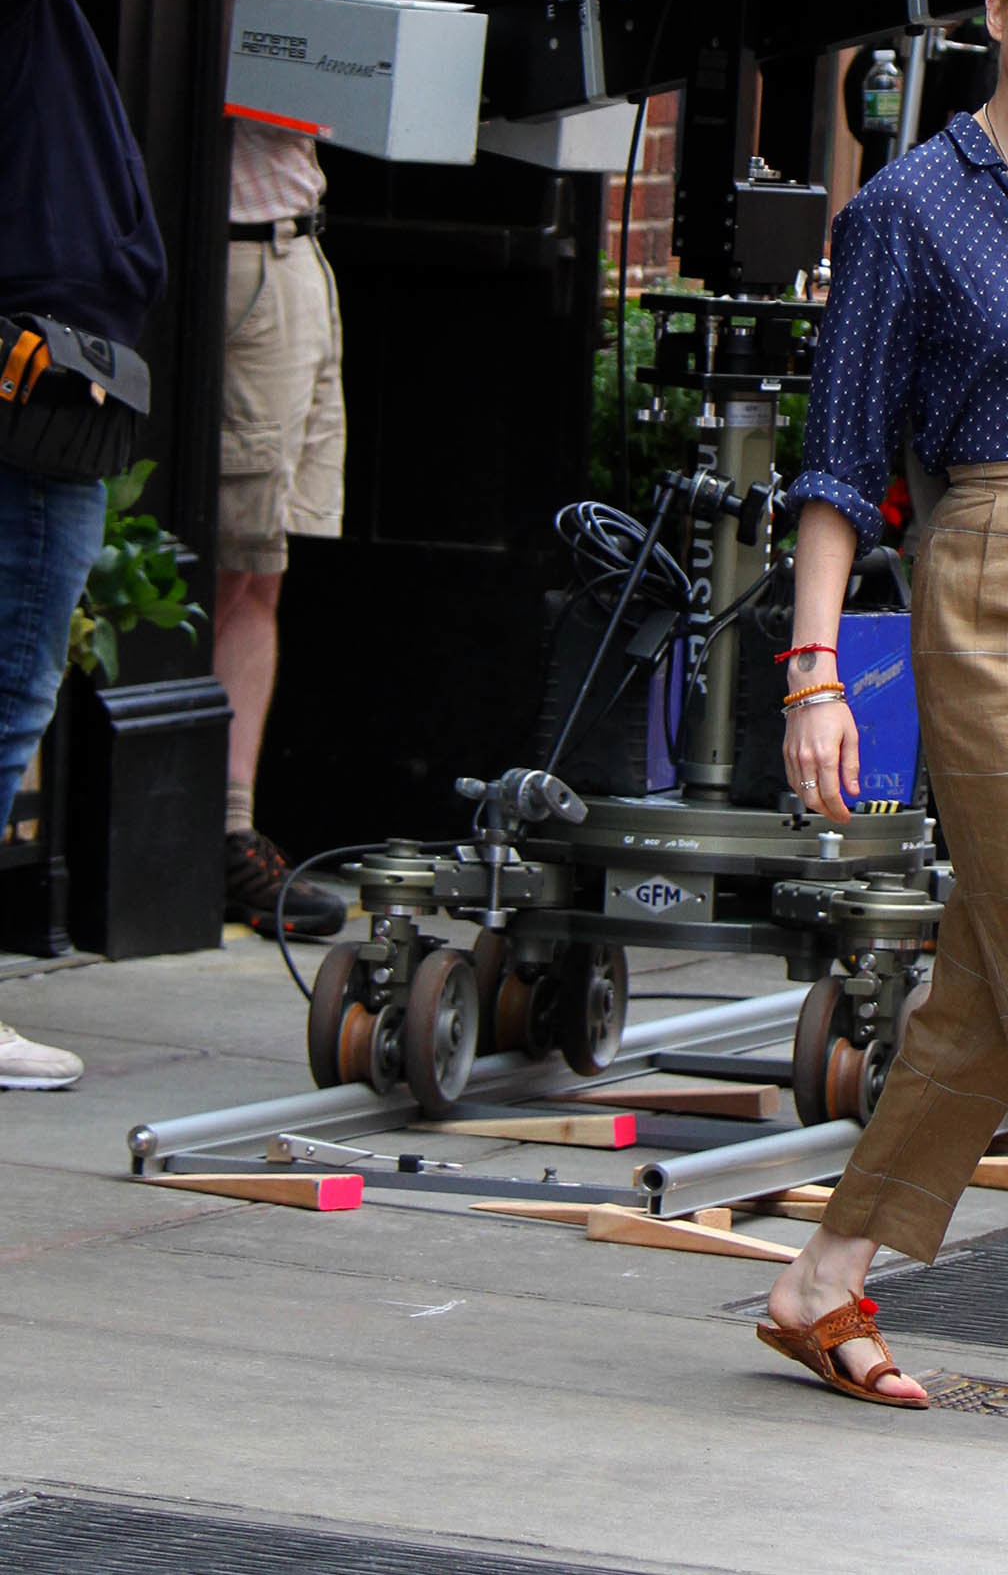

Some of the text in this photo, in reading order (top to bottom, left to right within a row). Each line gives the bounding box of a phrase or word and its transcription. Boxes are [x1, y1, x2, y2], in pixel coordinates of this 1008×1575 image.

[243, 29, 308, 47] MONSTER
[241, 41, 307, 59] REMOTES
[636, 884, 681, 907] GFM
